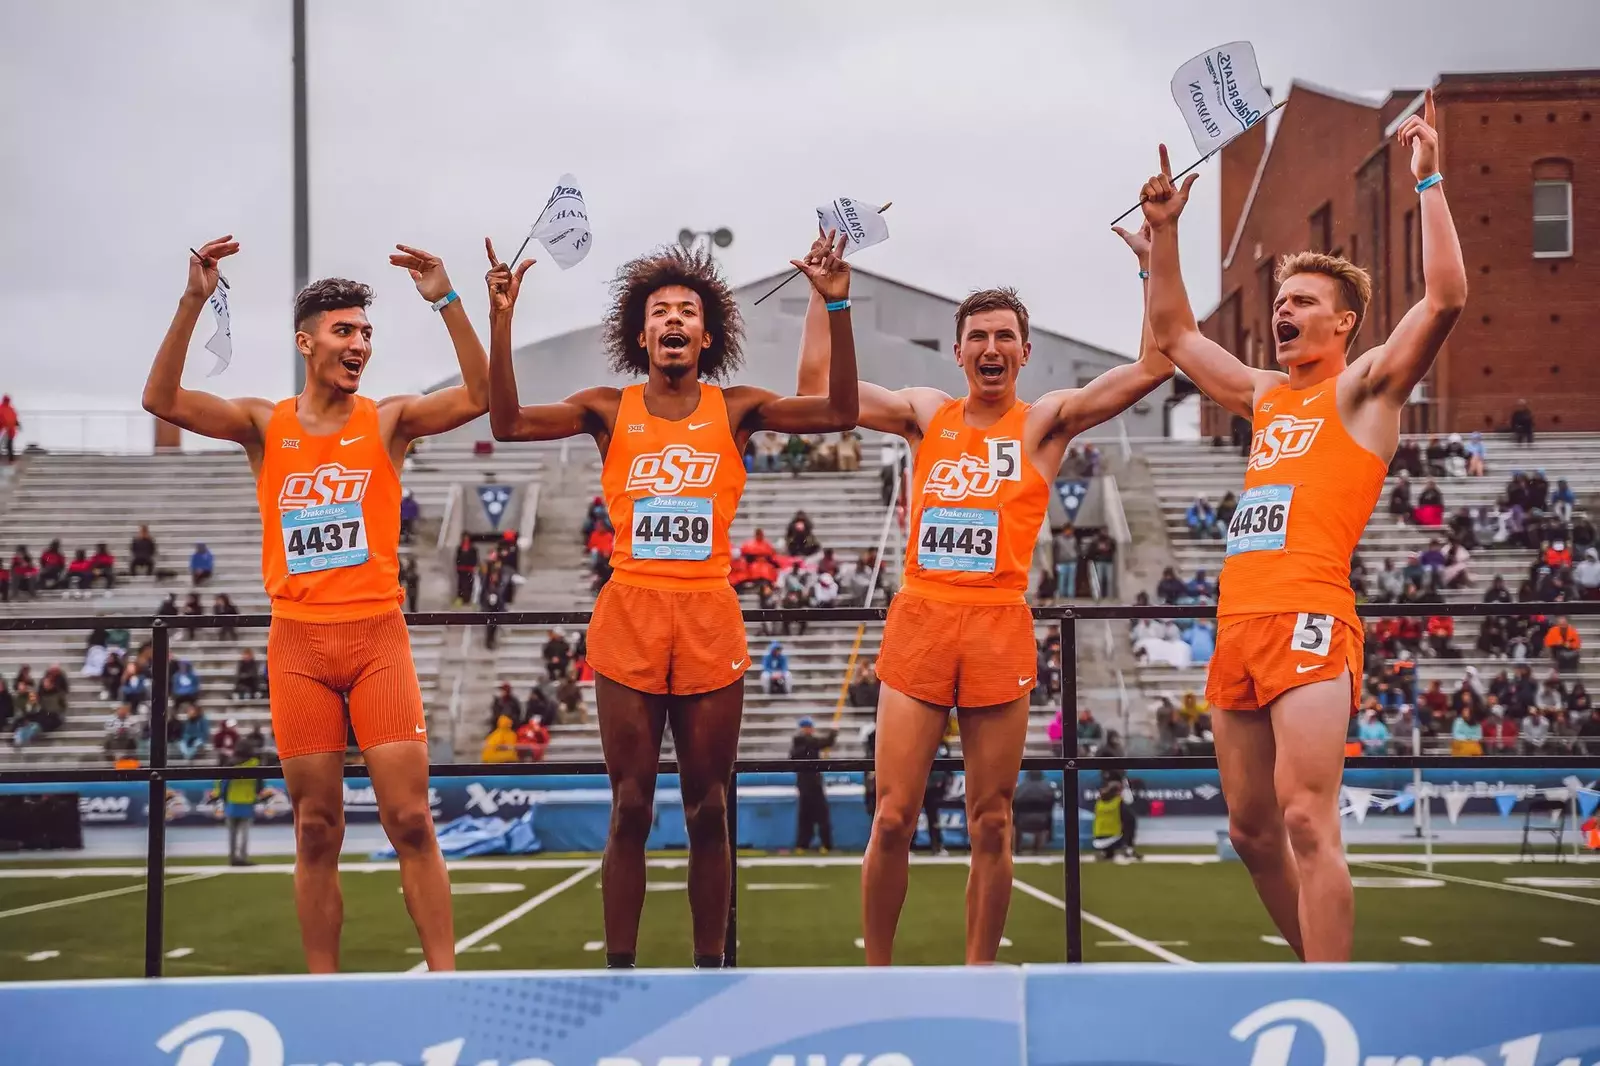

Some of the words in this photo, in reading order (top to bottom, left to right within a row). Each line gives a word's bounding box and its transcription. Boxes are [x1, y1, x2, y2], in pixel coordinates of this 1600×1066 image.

[844, 207, 865, 239] RELAYS
[625, 444, 721, 496] OSU
[996, 442, 1014, 478] 5
[278, 462, 372, 510] OSU
[938, 508, 962, 517] Drake
[1229, 504, 1285, 538] 4436
[288, 520, 360, 556] 4437
[921, 526, 993, 556] 4443
[1300, 613, 1327, 650] 5
